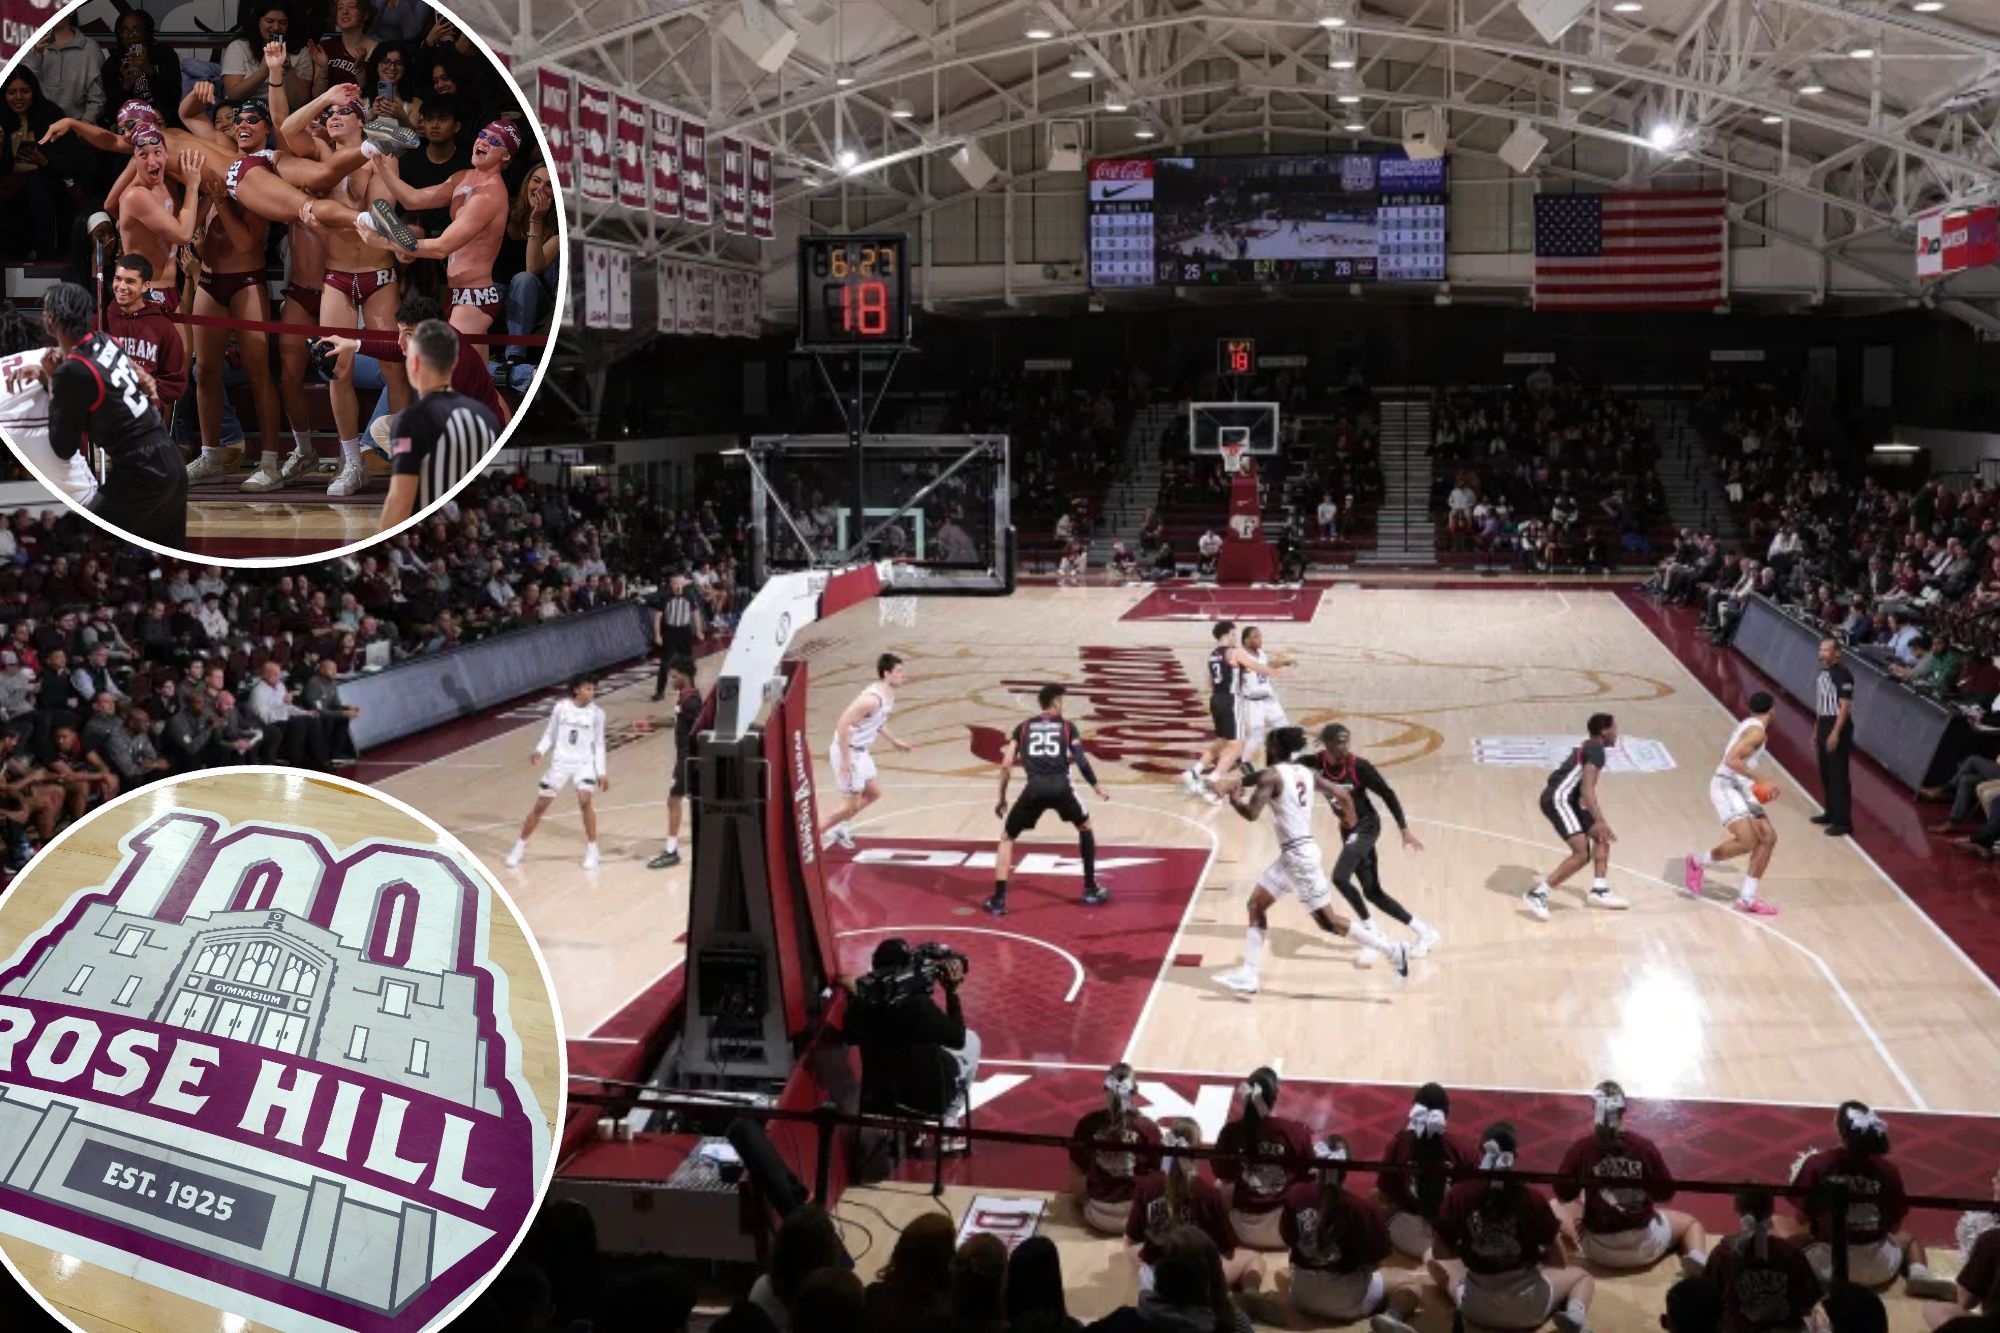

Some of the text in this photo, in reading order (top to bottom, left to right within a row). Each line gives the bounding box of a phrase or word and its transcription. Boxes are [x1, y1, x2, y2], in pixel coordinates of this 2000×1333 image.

[832, 249, 893, 277] 6:27
[452, 287, 500, 306] RAMS
[842, 281, 887, 335] 18
[1232, 352, 1248, 371] 18
[1212, 662, 1223, 684] 3
[1029, 732, 1060, 756] 25
[1296, 781, 1307, 807] 2
[112, 812, 478, 973] 100
[214, 984, 281, 1005] GYMNASIUM
[0, 1004, 498, 1211] ROSE HILL
[102, 1161, 237, 1222] EST. 1925
